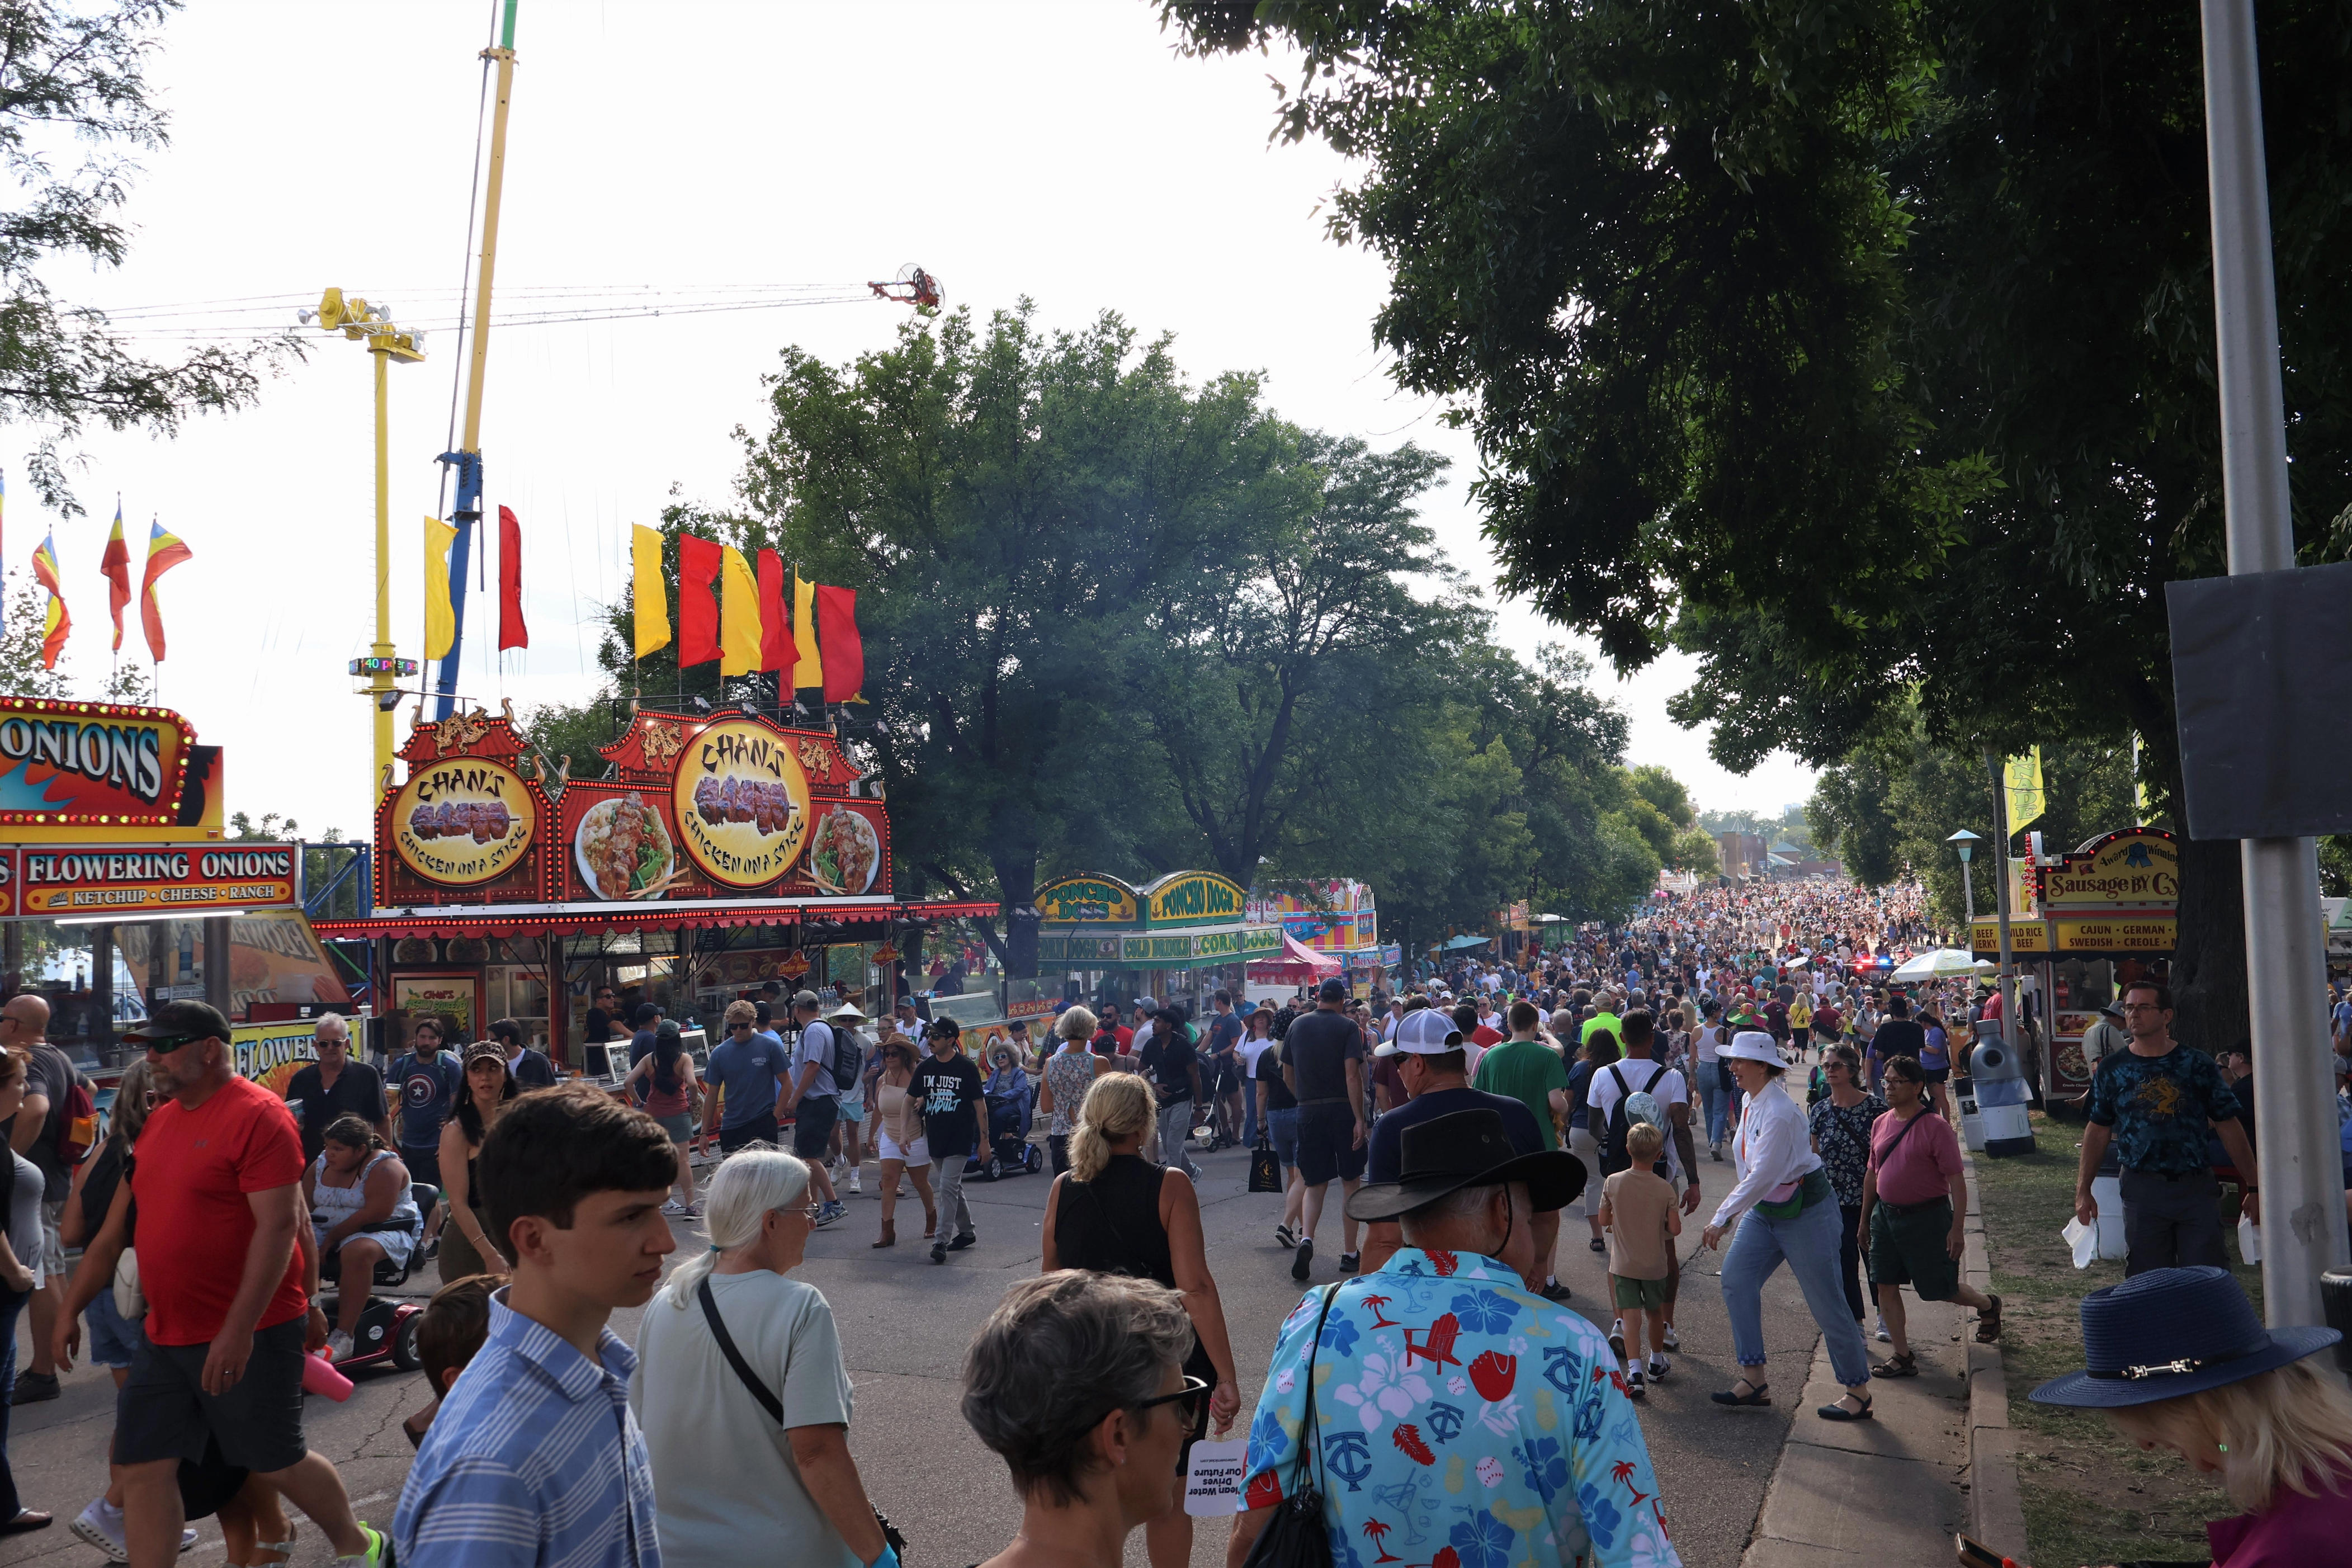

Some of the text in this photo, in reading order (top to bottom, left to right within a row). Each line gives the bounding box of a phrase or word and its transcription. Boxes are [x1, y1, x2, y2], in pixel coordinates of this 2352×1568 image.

[0, 717, 163, 804] ONIONS
[701, 733, 785, 778] CHAN'S
[417, 768, 505, 802] CHAN'S
[400, 826, 527, 875] CHICKEN ON A STICK
[684, 811, 804, 875] CHICKEN ON A STICK
[2099, 846, 2128, 867] Award
[27, 852, 191, 884] FLOWERING
[200, 851, 291, 881] ONIONS
[73, 887, 148, 905] KETCHUP
[160, 886, 218, 902] CHEESE
[229, 885, 275, 899] RANCH
[1046, 882, 1122, 905] PONCHO
[2050, 875, 2129, 899] Sausage
[2131, 874, 2150, 894] BY
[1162, 880, 1234, 917] PONCHO DOGS
[1976, 929, 1994, 938] BEEF
[2026, 927, 2042, 937] RICE
[2080, 925, 2165, 934] CAJUN GERMAN
[1068, 939, 1097, 958] DOGS
[1124, 938, 1189, 958] COLD DRINKS
[1202, 930, 1275, 953] CORN DOGS
[1976, 939, 1996, 949] JERKY
[2016, 938, 2034, 948] BEEF
[2069, 937, 2113, 947] SWEDISH
[2124, 937, 2160, 947] CREOLE
[780, 963, 809, 973] Order Here
[923, 1075, 962, 1089] I'M JUST
[931, 1098, 962, 1116] ADULT
[1194, 1468, 1224, 1477] Future
[1188, 1486, 1238, 1496] lean Water
[1203, 1478, 1232, 1487] Drives
